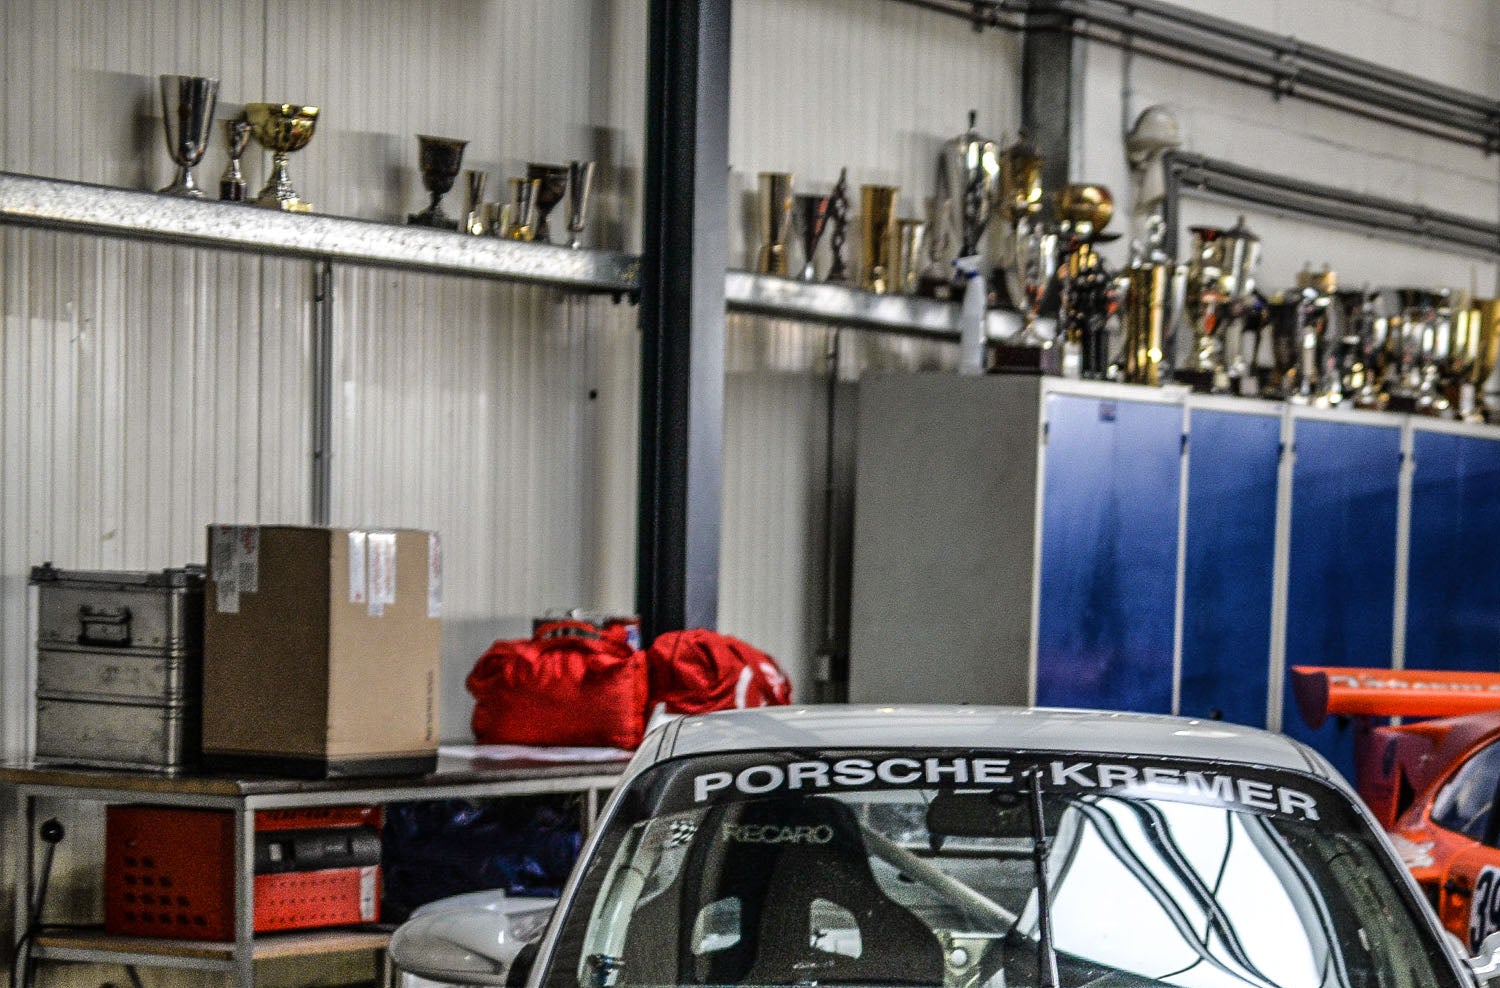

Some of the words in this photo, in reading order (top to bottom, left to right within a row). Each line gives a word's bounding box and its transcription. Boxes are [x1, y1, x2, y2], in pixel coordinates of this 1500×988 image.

[693, 758, 1012, 801] PORSCHE
[1050, 761, 1322, 822] KREMER
[721, 823, 835, 844] RECARO
